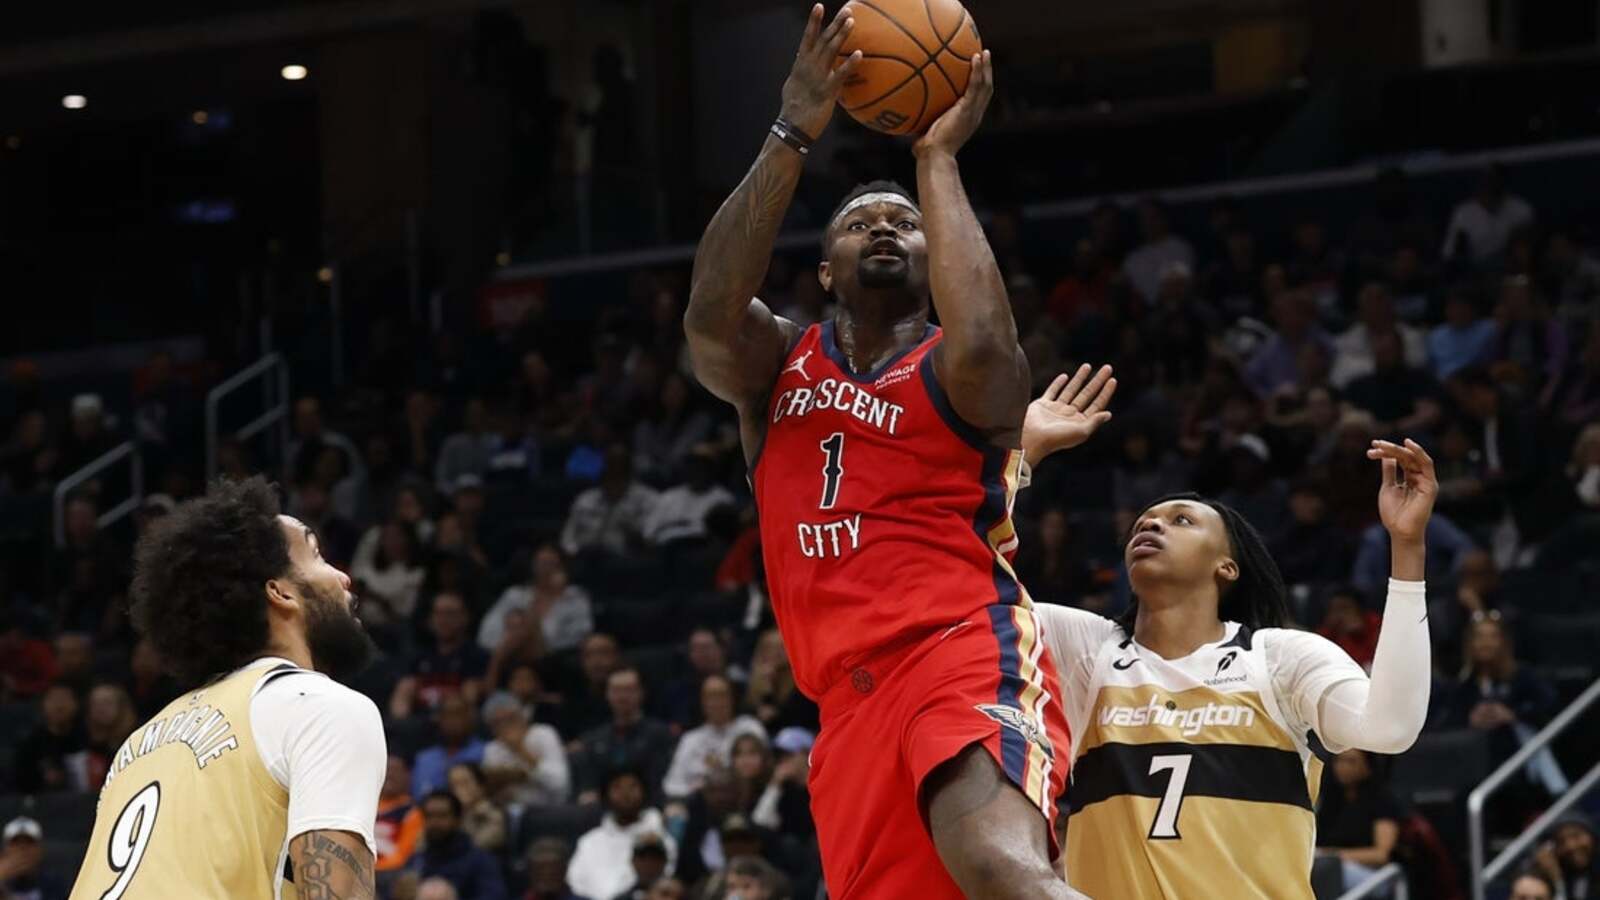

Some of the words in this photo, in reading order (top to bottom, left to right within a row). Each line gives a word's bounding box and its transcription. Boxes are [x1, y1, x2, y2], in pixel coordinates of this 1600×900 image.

[819, 432, 844, 509] 1
[797, 513, 862, 558] CITY
[1100, 694, 1255, 736] washington
[1148, 753, 1193, 840] 7
[99, 780, 161, 900] 9
